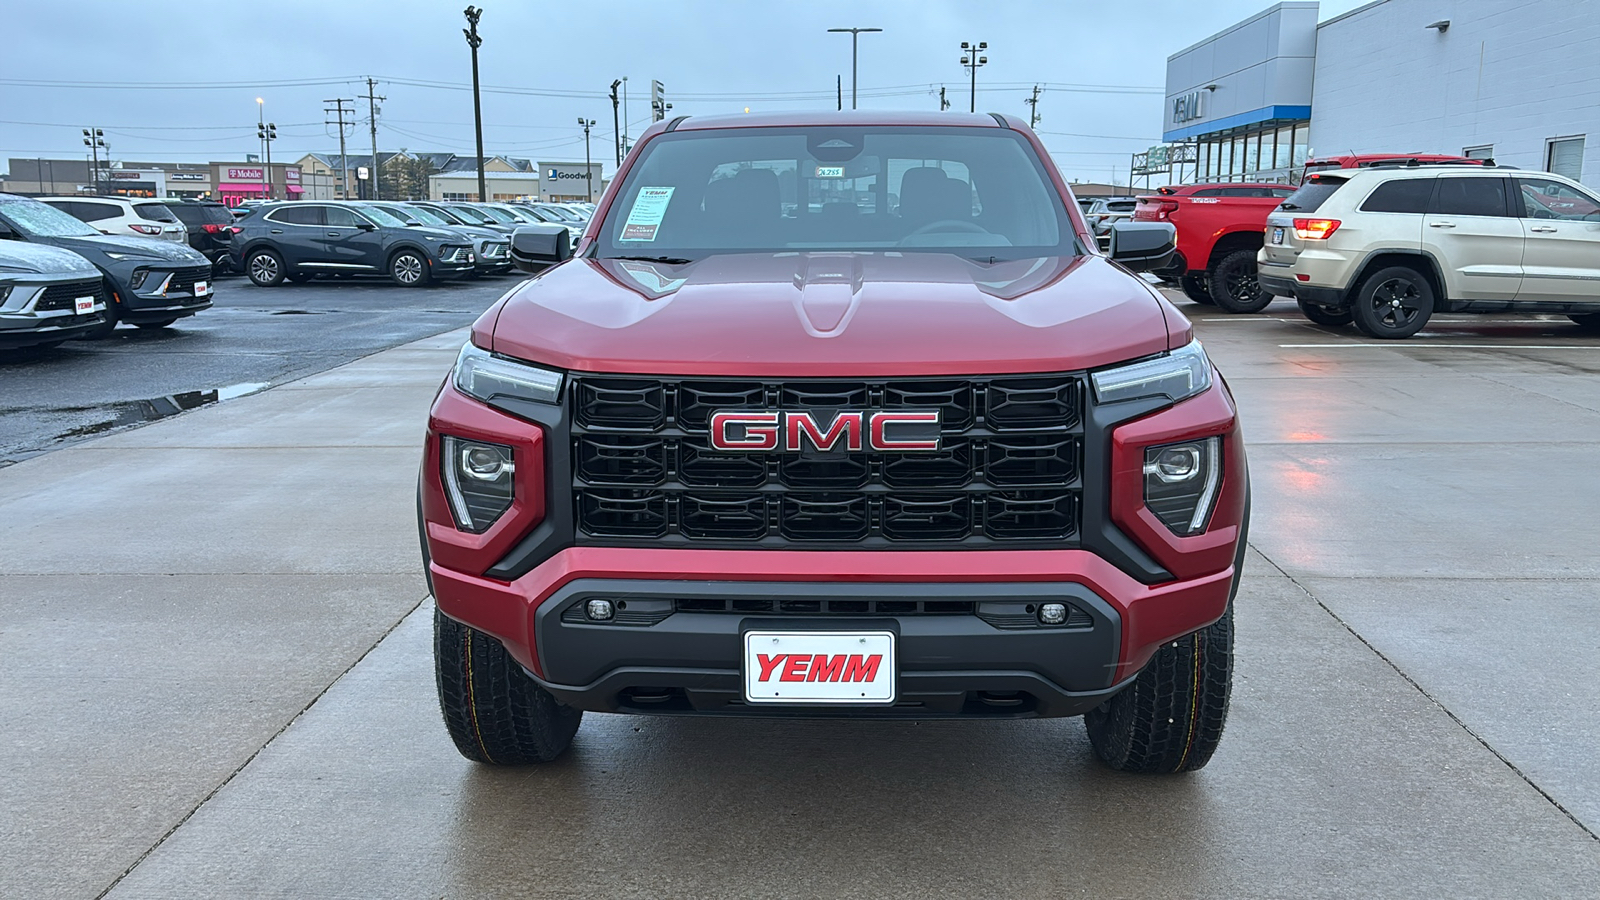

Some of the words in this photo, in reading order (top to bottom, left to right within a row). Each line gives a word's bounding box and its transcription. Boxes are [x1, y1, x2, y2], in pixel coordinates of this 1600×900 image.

[237, 169, 261, 178] Mobile
[710, 411, 939, 451] GMC
[756, 653, 883, 682] YEMM
